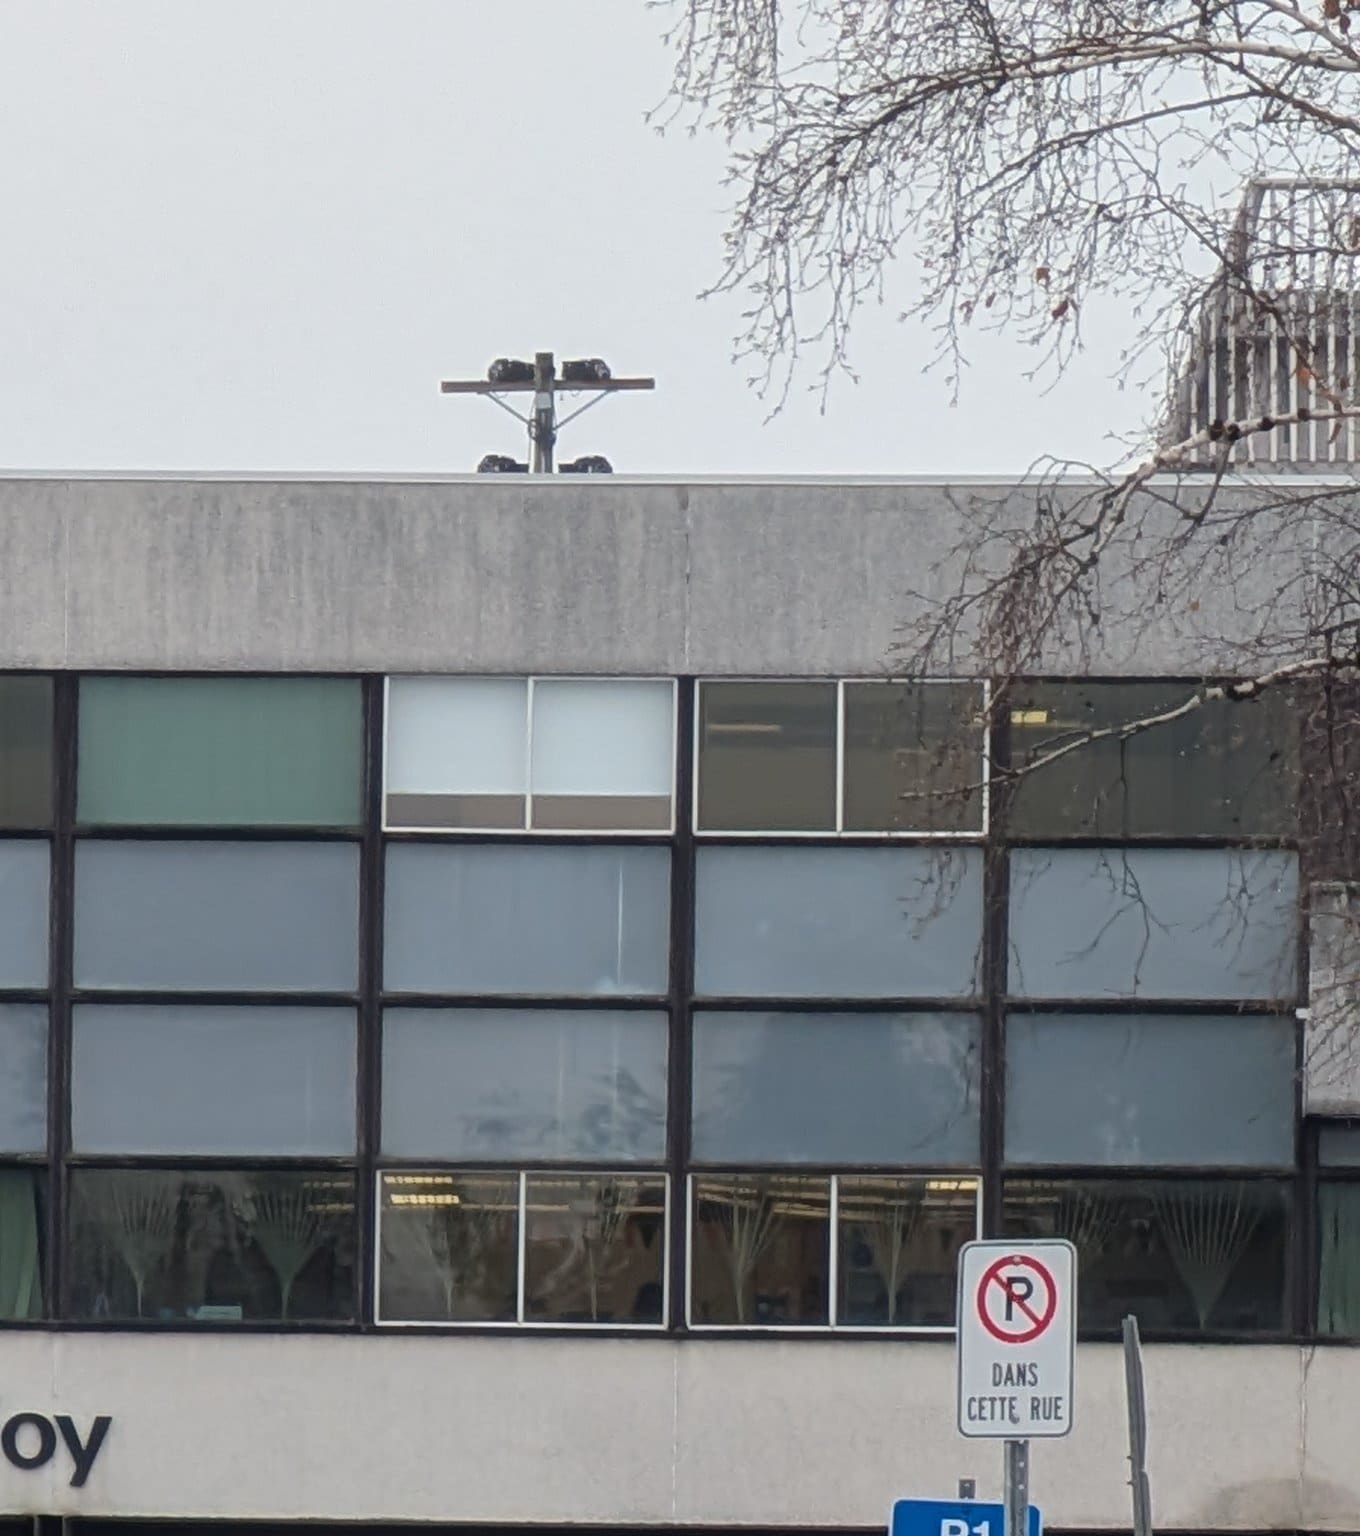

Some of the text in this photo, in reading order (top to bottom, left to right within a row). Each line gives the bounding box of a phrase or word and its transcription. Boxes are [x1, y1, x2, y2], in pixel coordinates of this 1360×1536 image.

[992, 1362, 1039, 1387] DANS
[967, 1396, 1064, 1422] CETTE RUE
